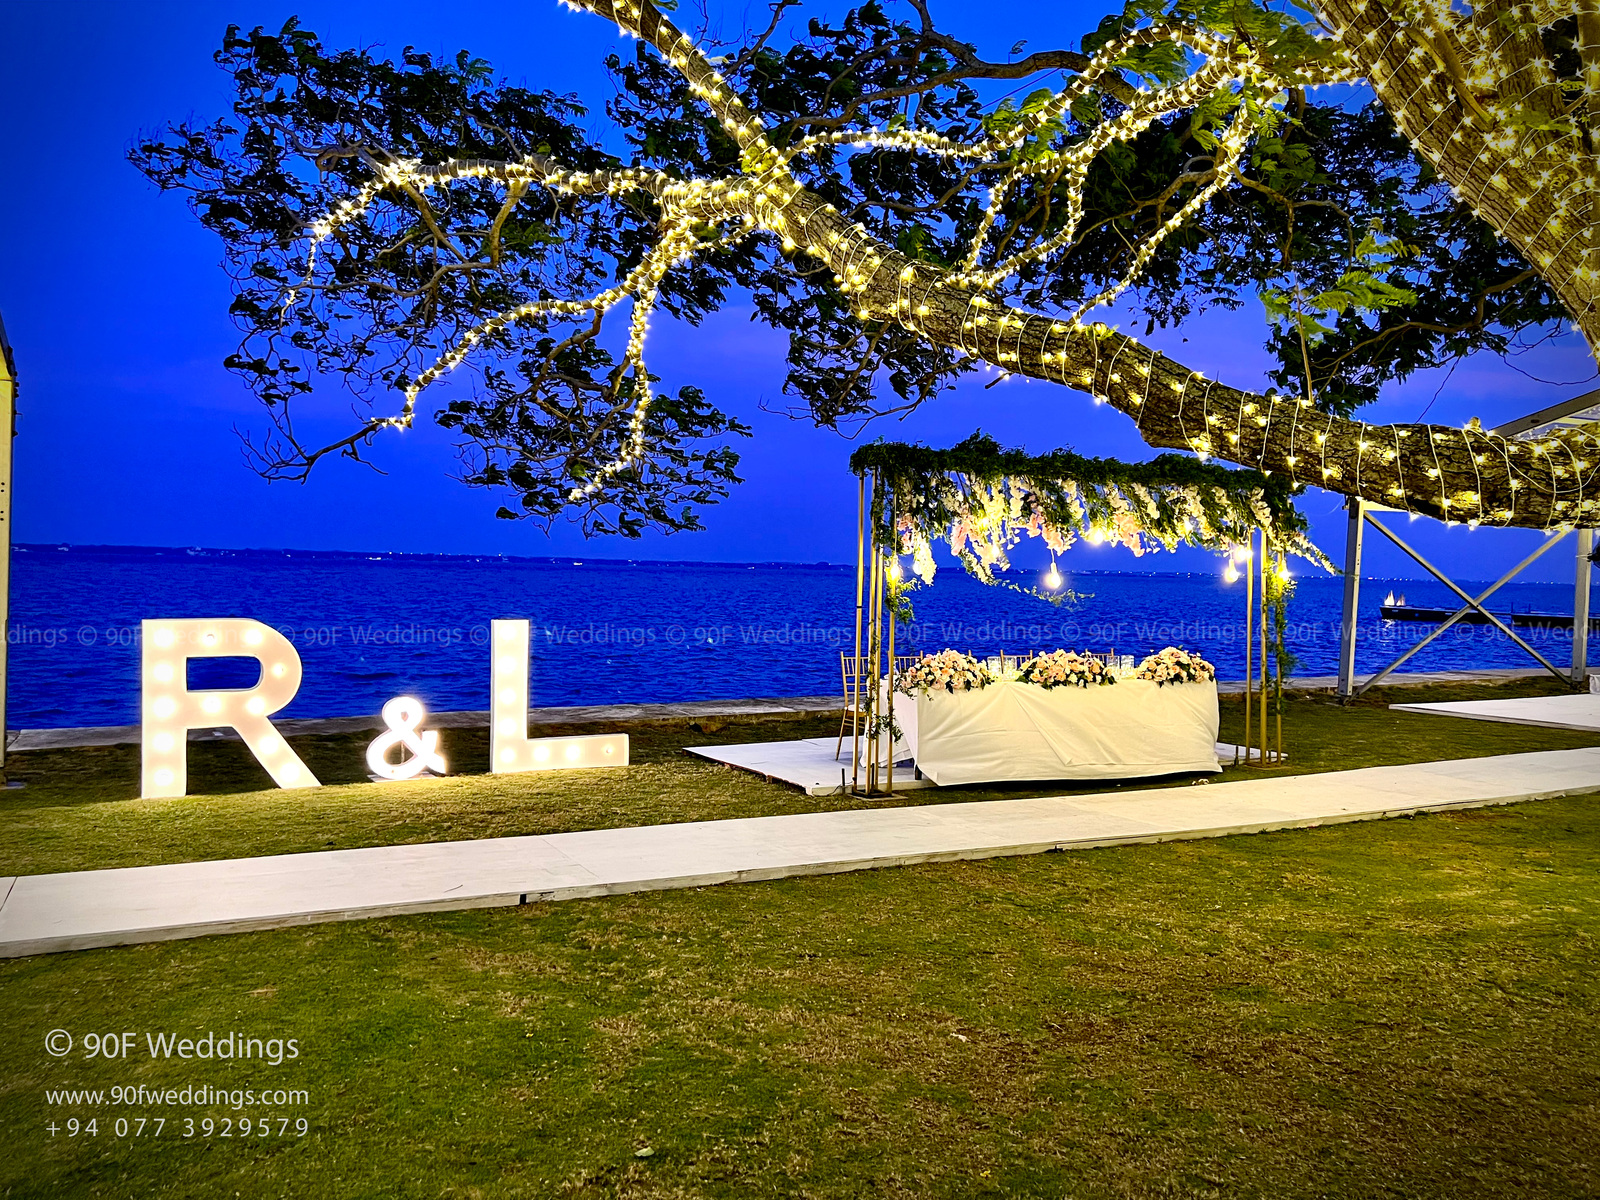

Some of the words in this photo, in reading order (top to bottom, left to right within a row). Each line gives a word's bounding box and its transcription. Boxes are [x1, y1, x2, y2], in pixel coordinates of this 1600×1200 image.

[140, 617, 320, 799] R
[365, 696, 448, 781] &
[490, 619, 630, 774] L
